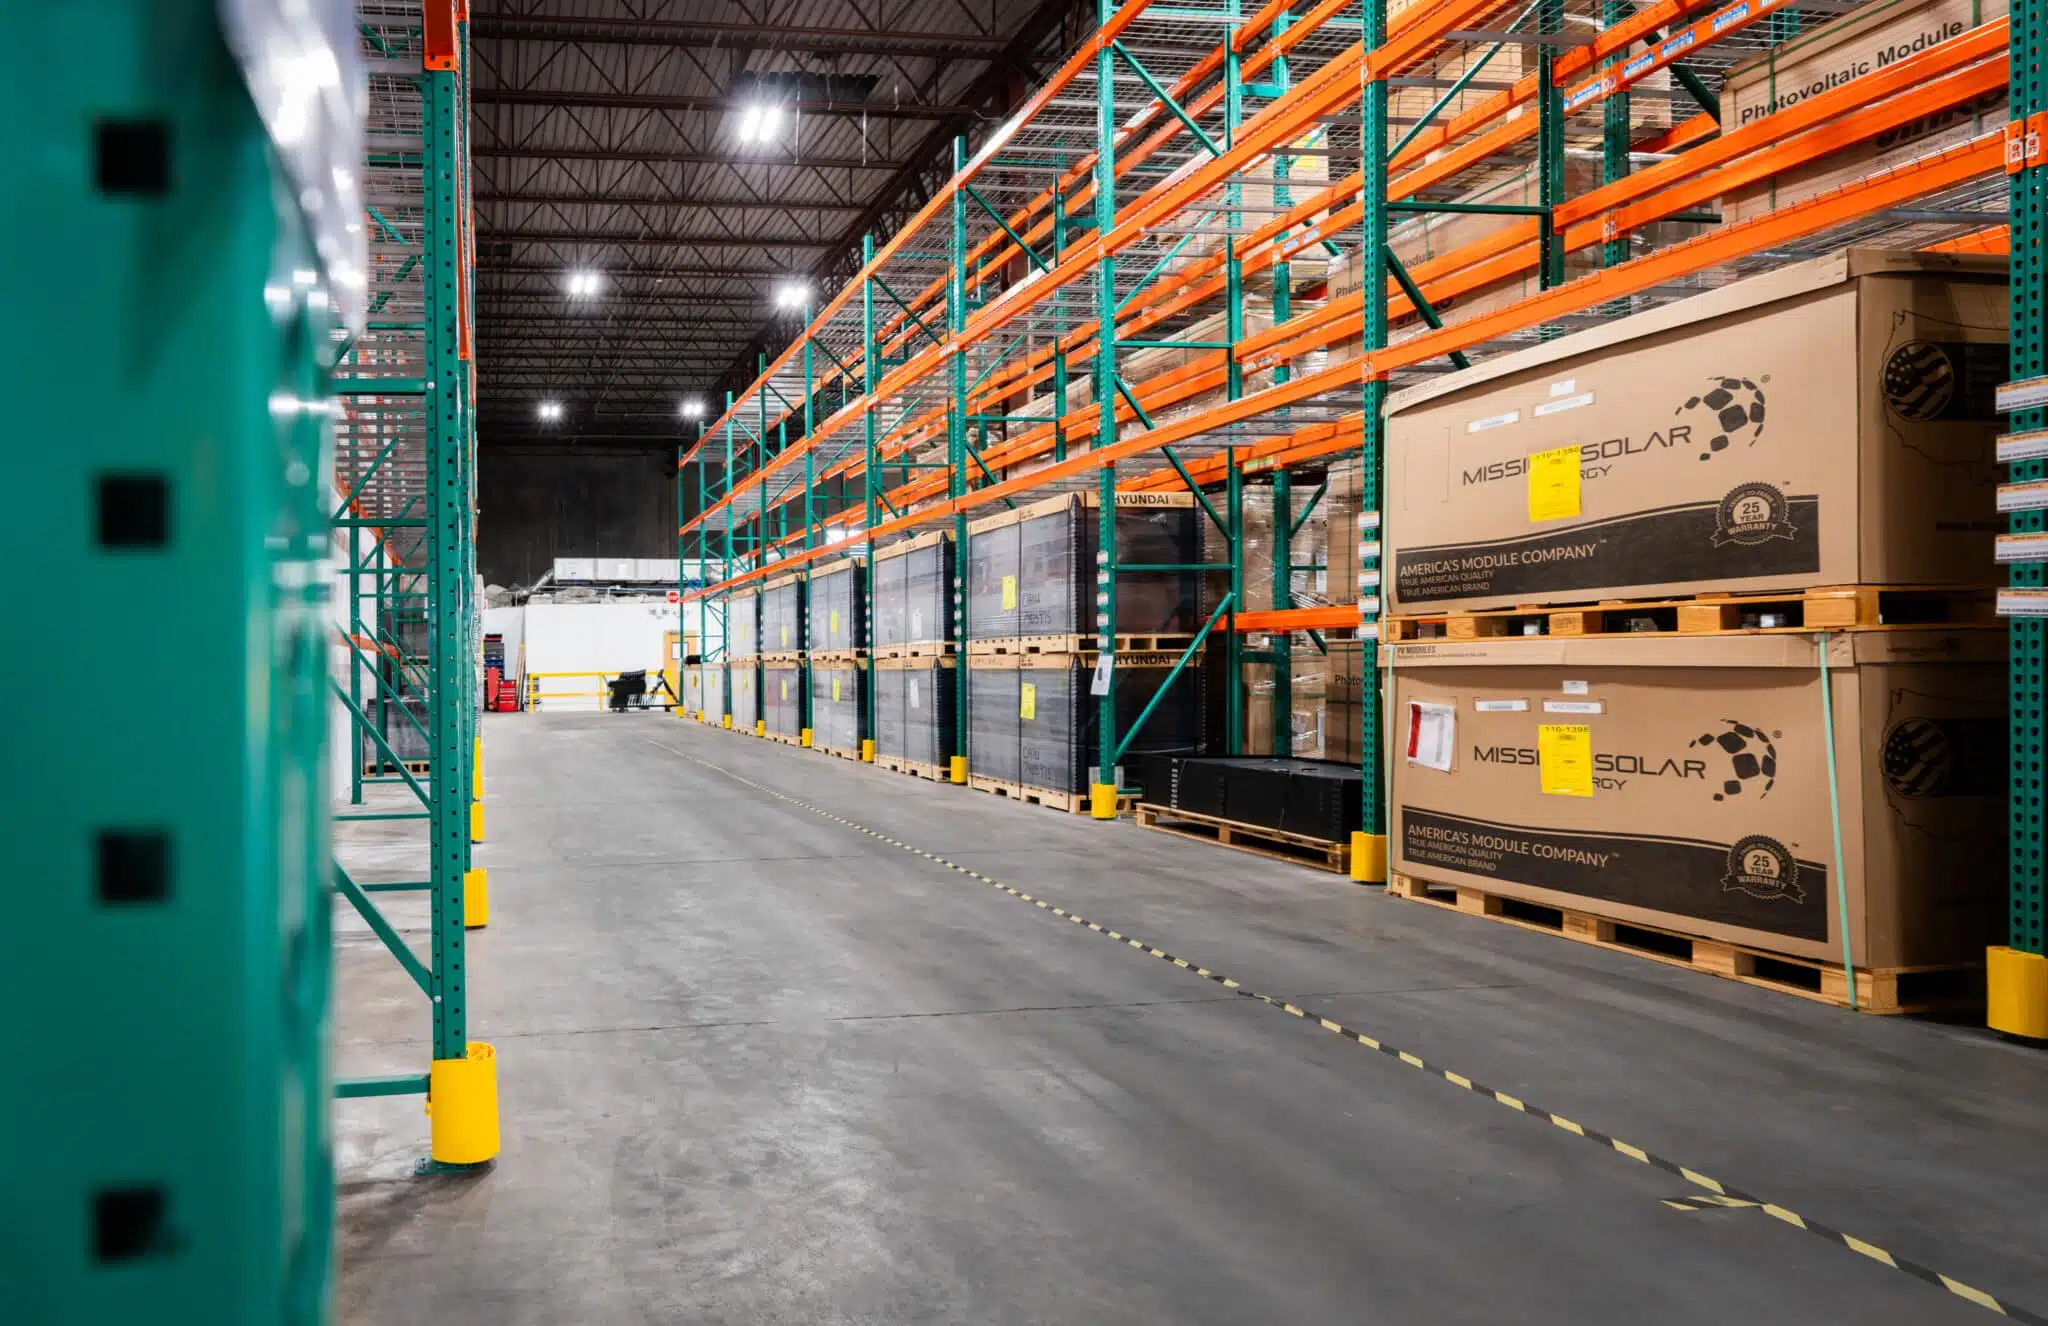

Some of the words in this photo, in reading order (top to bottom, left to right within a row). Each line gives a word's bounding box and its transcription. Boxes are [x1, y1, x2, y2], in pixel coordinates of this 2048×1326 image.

[1741, 61, 1870, 124] Photovoltaic
[1877, 20, 1964, 68] Module
[1463, 458, 1530, 486] MISSI
[1579, 425, 1692, 463] SOLAR
[1579, 464, 1612, 480] RGY
[1115, 494, 1169, 504] HYUNDAI
[1742, 502, 1760, 515] 25
[1740, 513, 1765, 522] YEAR
[1727, 522, 1778, 535] WARRANTY
[1399, 559, 1460, 578] AMERICA'S
[1462, 552, 1518, 571] MODULE
[1522, 543, 1597, 564] COMPANY
[1400, 577, 1419, 587] TRUE
[1419, 573, 1460, 586] AMERICAN
[1460, 569, 1495, 581] QUALITY
[1402, 588, 1420, 597] TRUE
[1421, 584, 1462, 596] AMERICAN
[1462, 581, 1490, 592] BRAND
[1115, 655, 1171, 665] HYUNDAI
[1473, 745, 1540, 766] MISSI
[1594, 753, 1707, 780] SOLAR
[1592, 776, 1628, 791] RGY
[1407, 823, 1469, 845] AMERICA'S
[1471, 834, 1529, 855] MODULE
[1532, 843, 1609, 869] COMPANY
[1408, 837, 1426, 848] TRUE
[1426, 840, 1467, 856] AMERICAN
[1468, 847, 1504, 861] QUALITY
[1408, 848, 1426, 858] TRUE
[1426, 852, 1467, 867] AMERICAN
[1468, 859, 1497, 872] BRAND
[1752, 855, 1770, 868] 25
[1751, 867, 1774, 876] YEAR
[1736, 875, 1787, 890] WARRANTY
